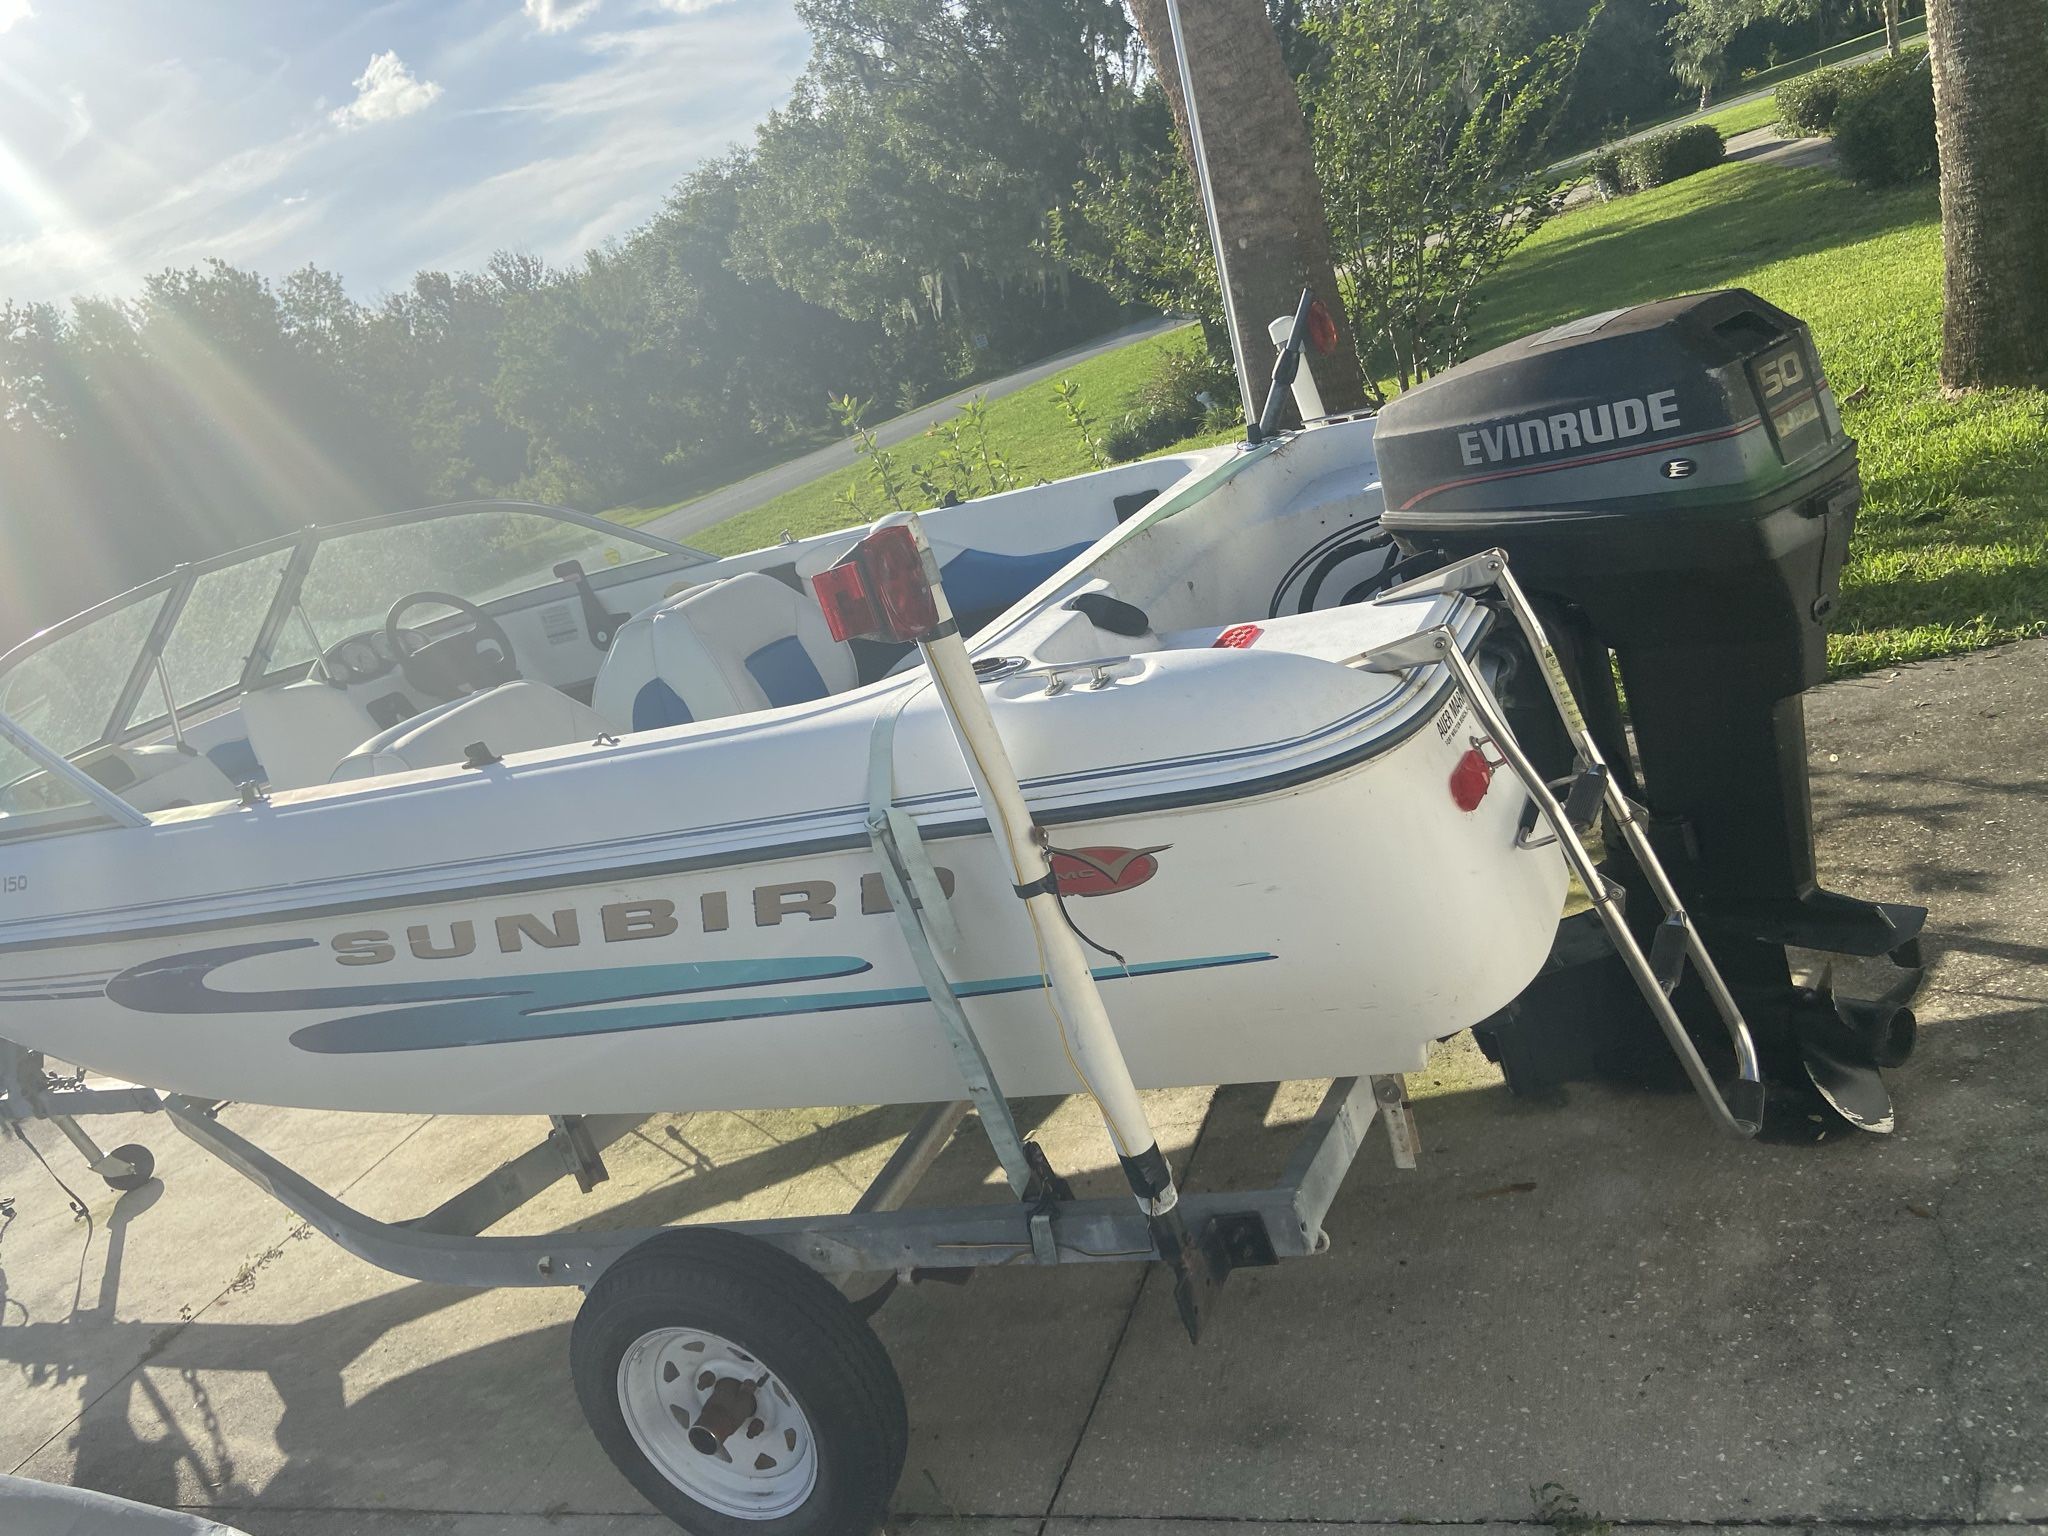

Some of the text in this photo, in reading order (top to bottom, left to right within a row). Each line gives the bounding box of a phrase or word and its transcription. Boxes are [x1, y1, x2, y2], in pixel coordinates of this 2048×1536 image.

[1758, 351, 1805, 399] 50
[1458, 389, 1681, 467] EVINRUDE
[1436, 690, 1466, 740] AUER MAR
[3, 874, 28, 894] 150
[1055, 868, 1097, 881] MC
